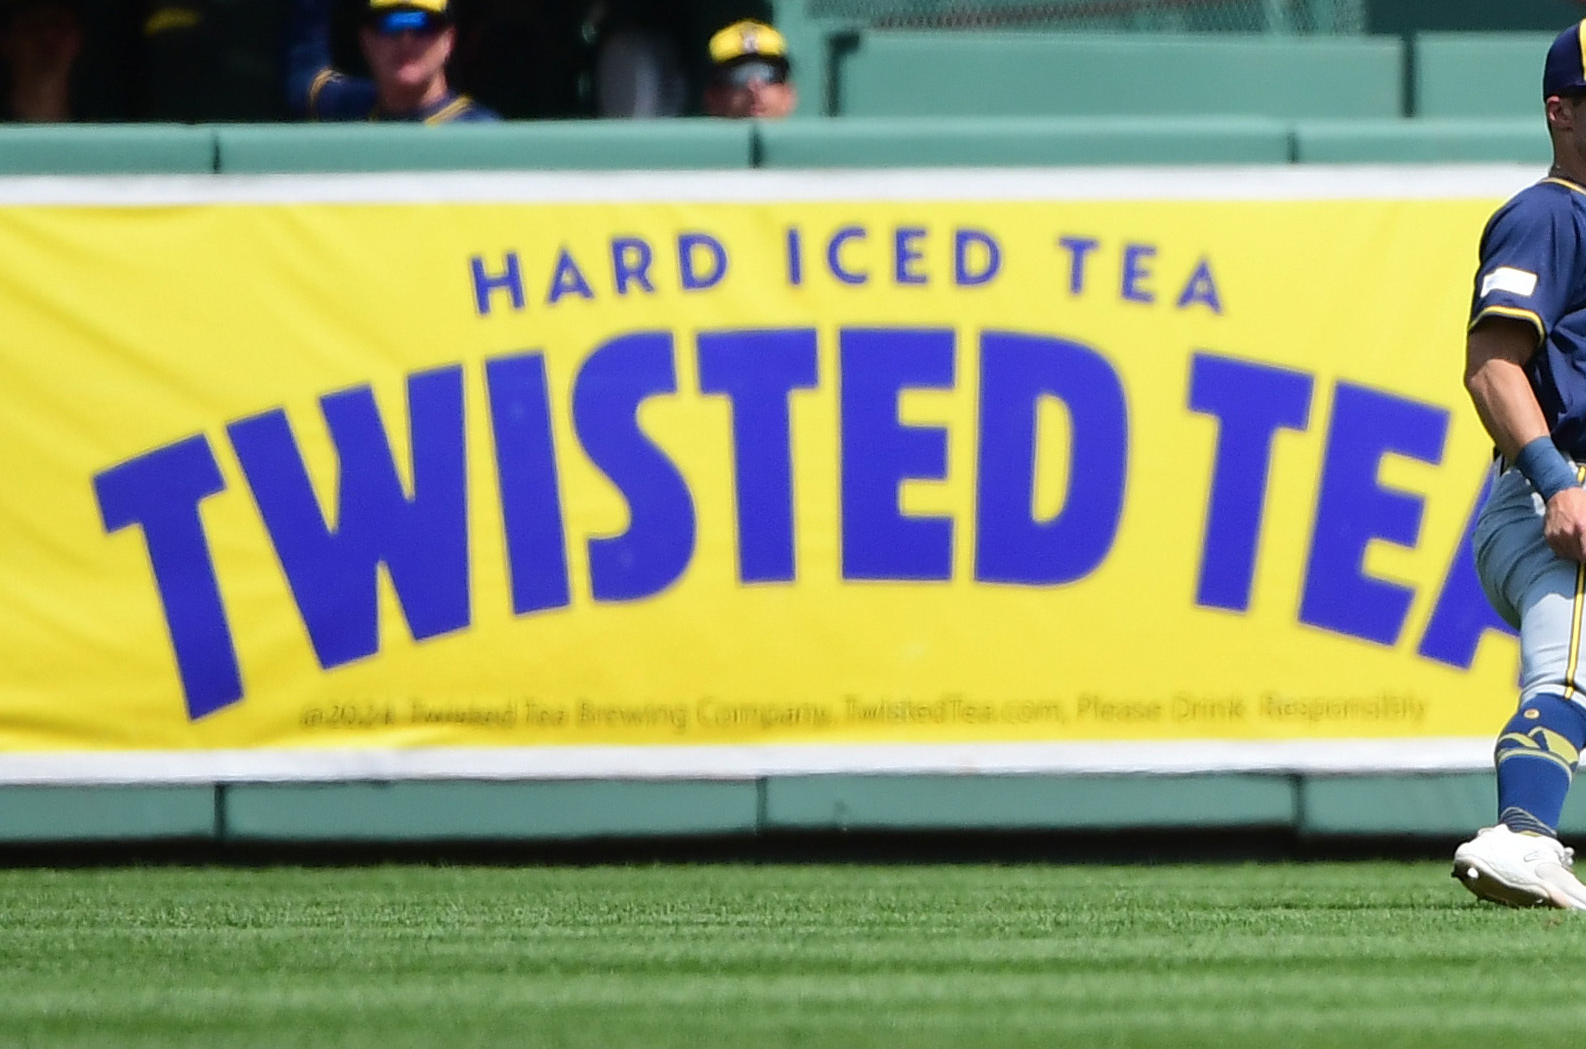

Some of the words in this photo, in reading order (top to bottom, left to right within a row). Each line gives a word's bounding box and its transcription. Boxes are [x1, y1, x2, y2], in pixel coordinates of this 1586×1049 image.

[471, 231, 727, 315] HARD
[785, 226, 1004, 288] ICED
[1058, 234, 1225, 314] TEA
[93, 328, 1129, 722] TWISTED
[577, 697, 689, 734] Brewing
[1075, 694, 1160, 723] Please
[1170, 693, 1243, 722] Drink
[1257, 691, 1427, 729] Responsibly
